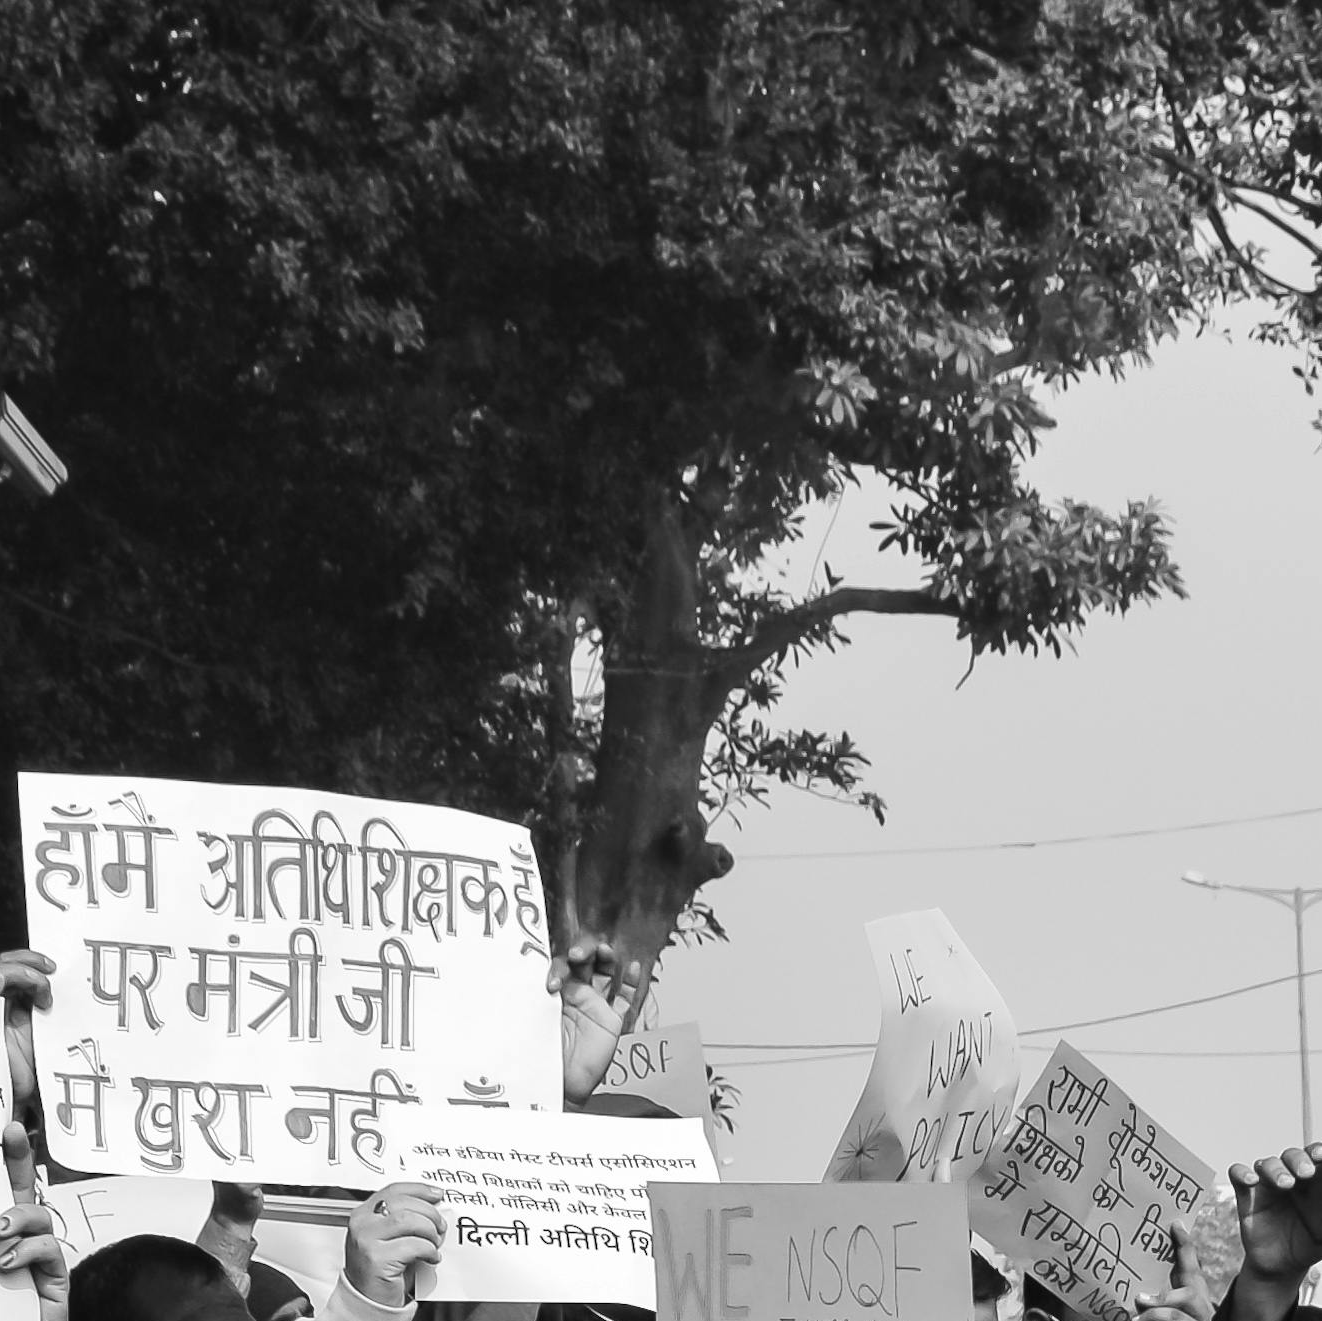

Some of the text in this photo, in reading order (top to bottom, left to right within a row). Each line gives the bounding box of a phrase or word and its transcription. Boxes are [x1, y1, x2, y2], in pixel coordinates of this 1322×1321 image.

[82, 926, 442, 1051] पर मंत्री जी
[888, 947, 933, 1015] WE
[601, 1038, 676, 1088] SQF
[925, 1011, 996, 1100] WANT
[456, 1216, 530, 1248] दिल्ली
[539, 1223, 621, 1253] अतिथि
[786, 1219, 923, 1319] NSQF
